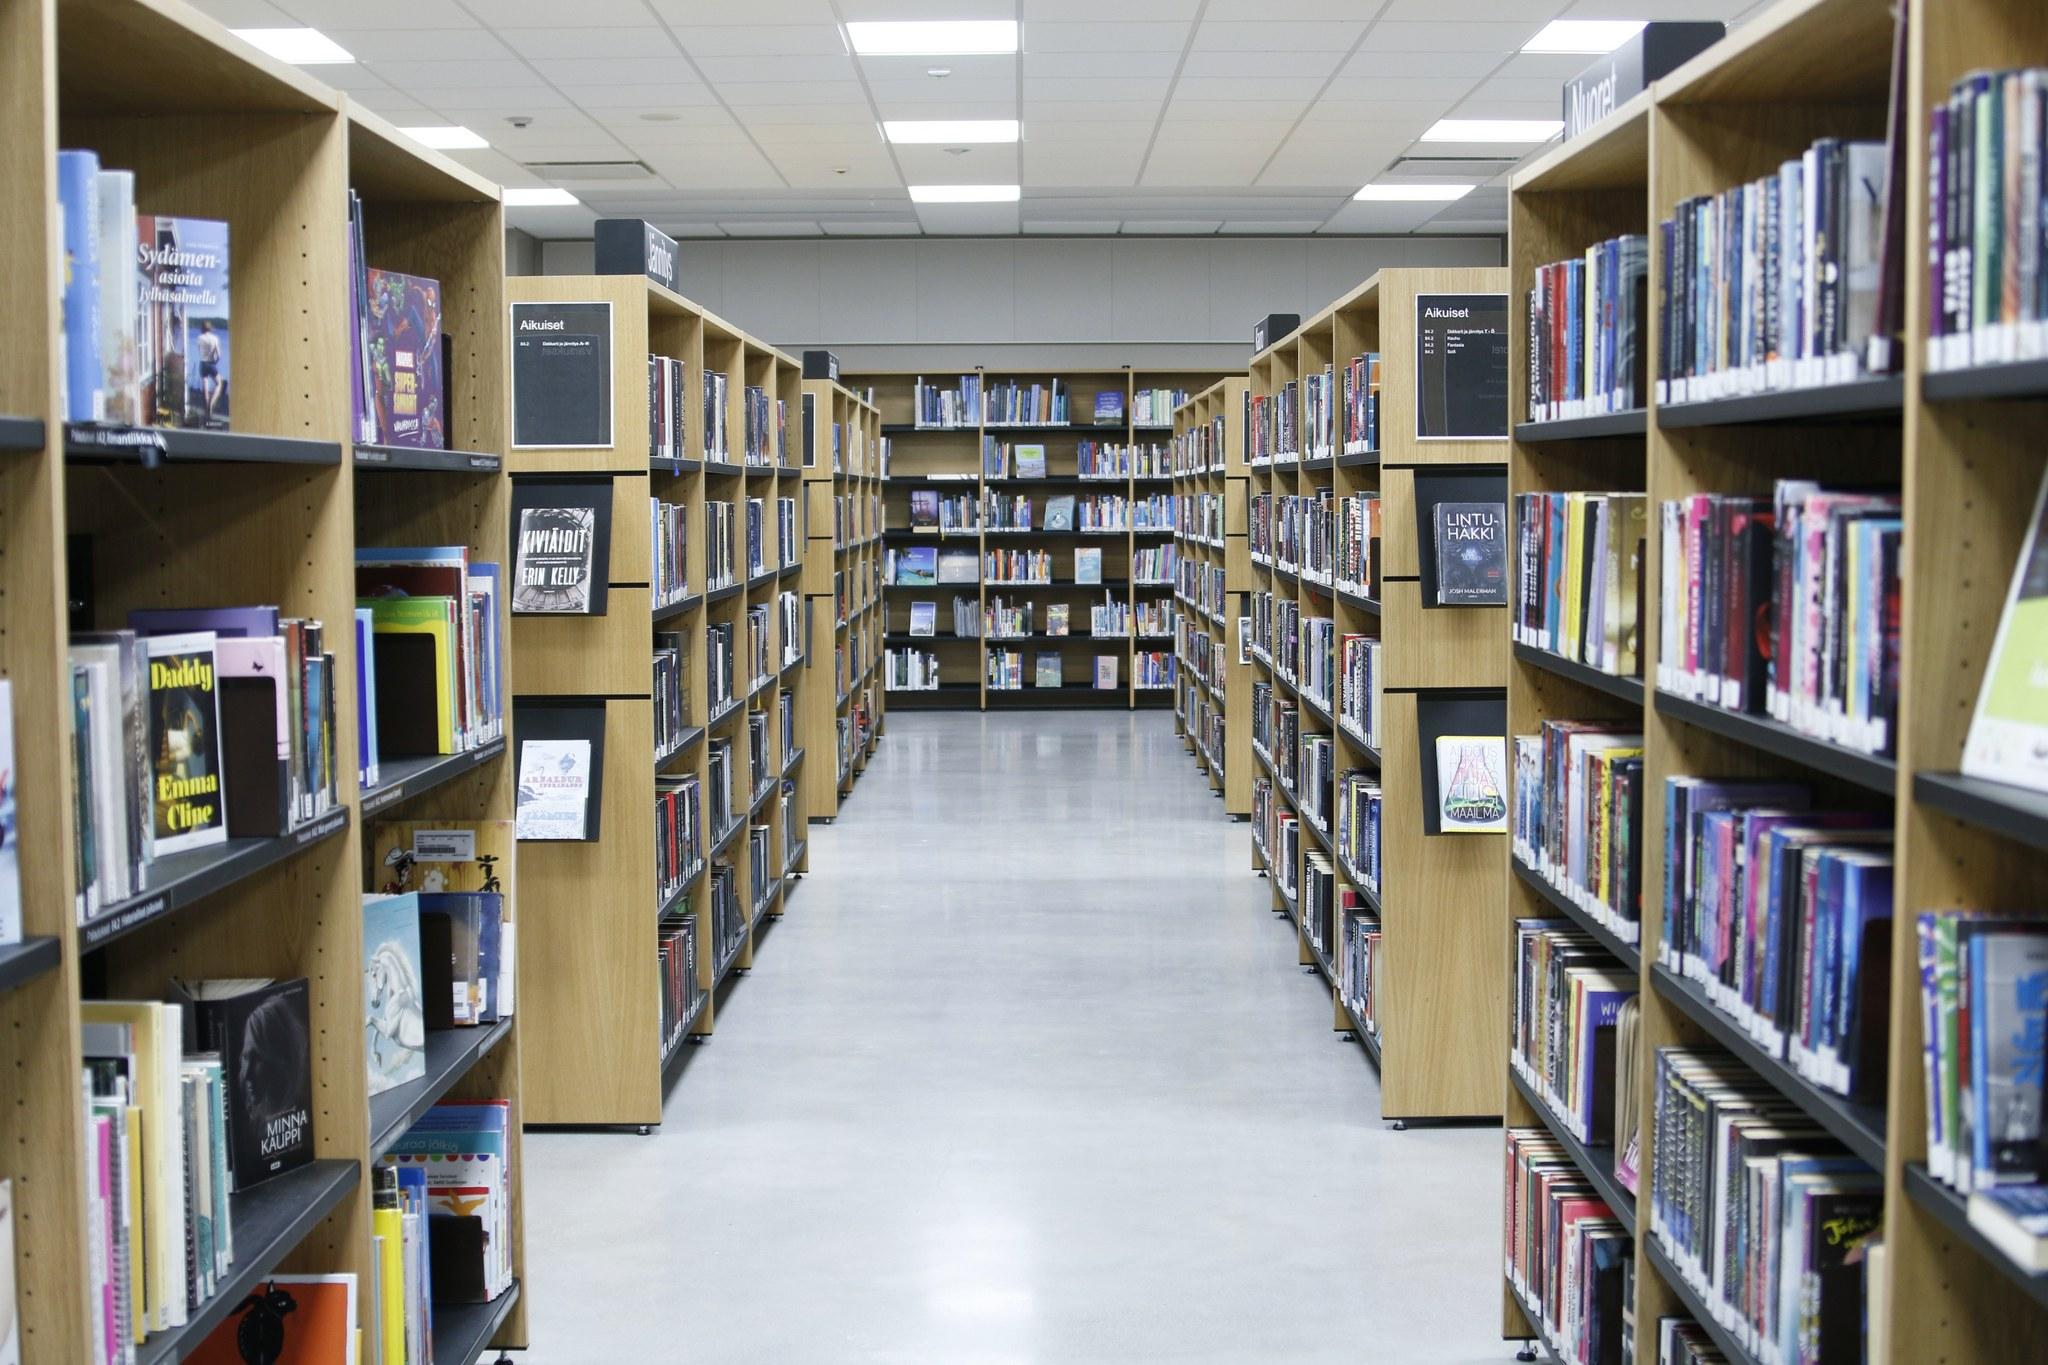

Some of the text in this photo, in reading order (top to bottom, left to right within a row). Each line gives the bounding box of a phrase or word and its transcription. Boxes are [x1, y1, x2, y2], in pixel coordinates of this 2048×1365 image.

[1571, 62, 1617, 137] Nuoret
[138, 243, 220, 270] Sydämen-
[159, 269, 202, 286] asioita
[1424, 307, 1469, 318] Aikuiset
[520, 320, 564, 330] Aikuiset
[1447, 513, 1499, 526] LINTU-
[1447, 524, 1494, 540] HÄKKI
[522, 567, 580, 586] ERIN KELLY
[151, 657, 214, 692] Daddy
[157, 773, 218, 801] Emma
[166, 802, 214, 831] Cline
[1450, 807, 1500, 819] MAAILMA
[266, 1109, 308, 1138] MINNA
[260, 1127, 301, 1156] KAUPPI
